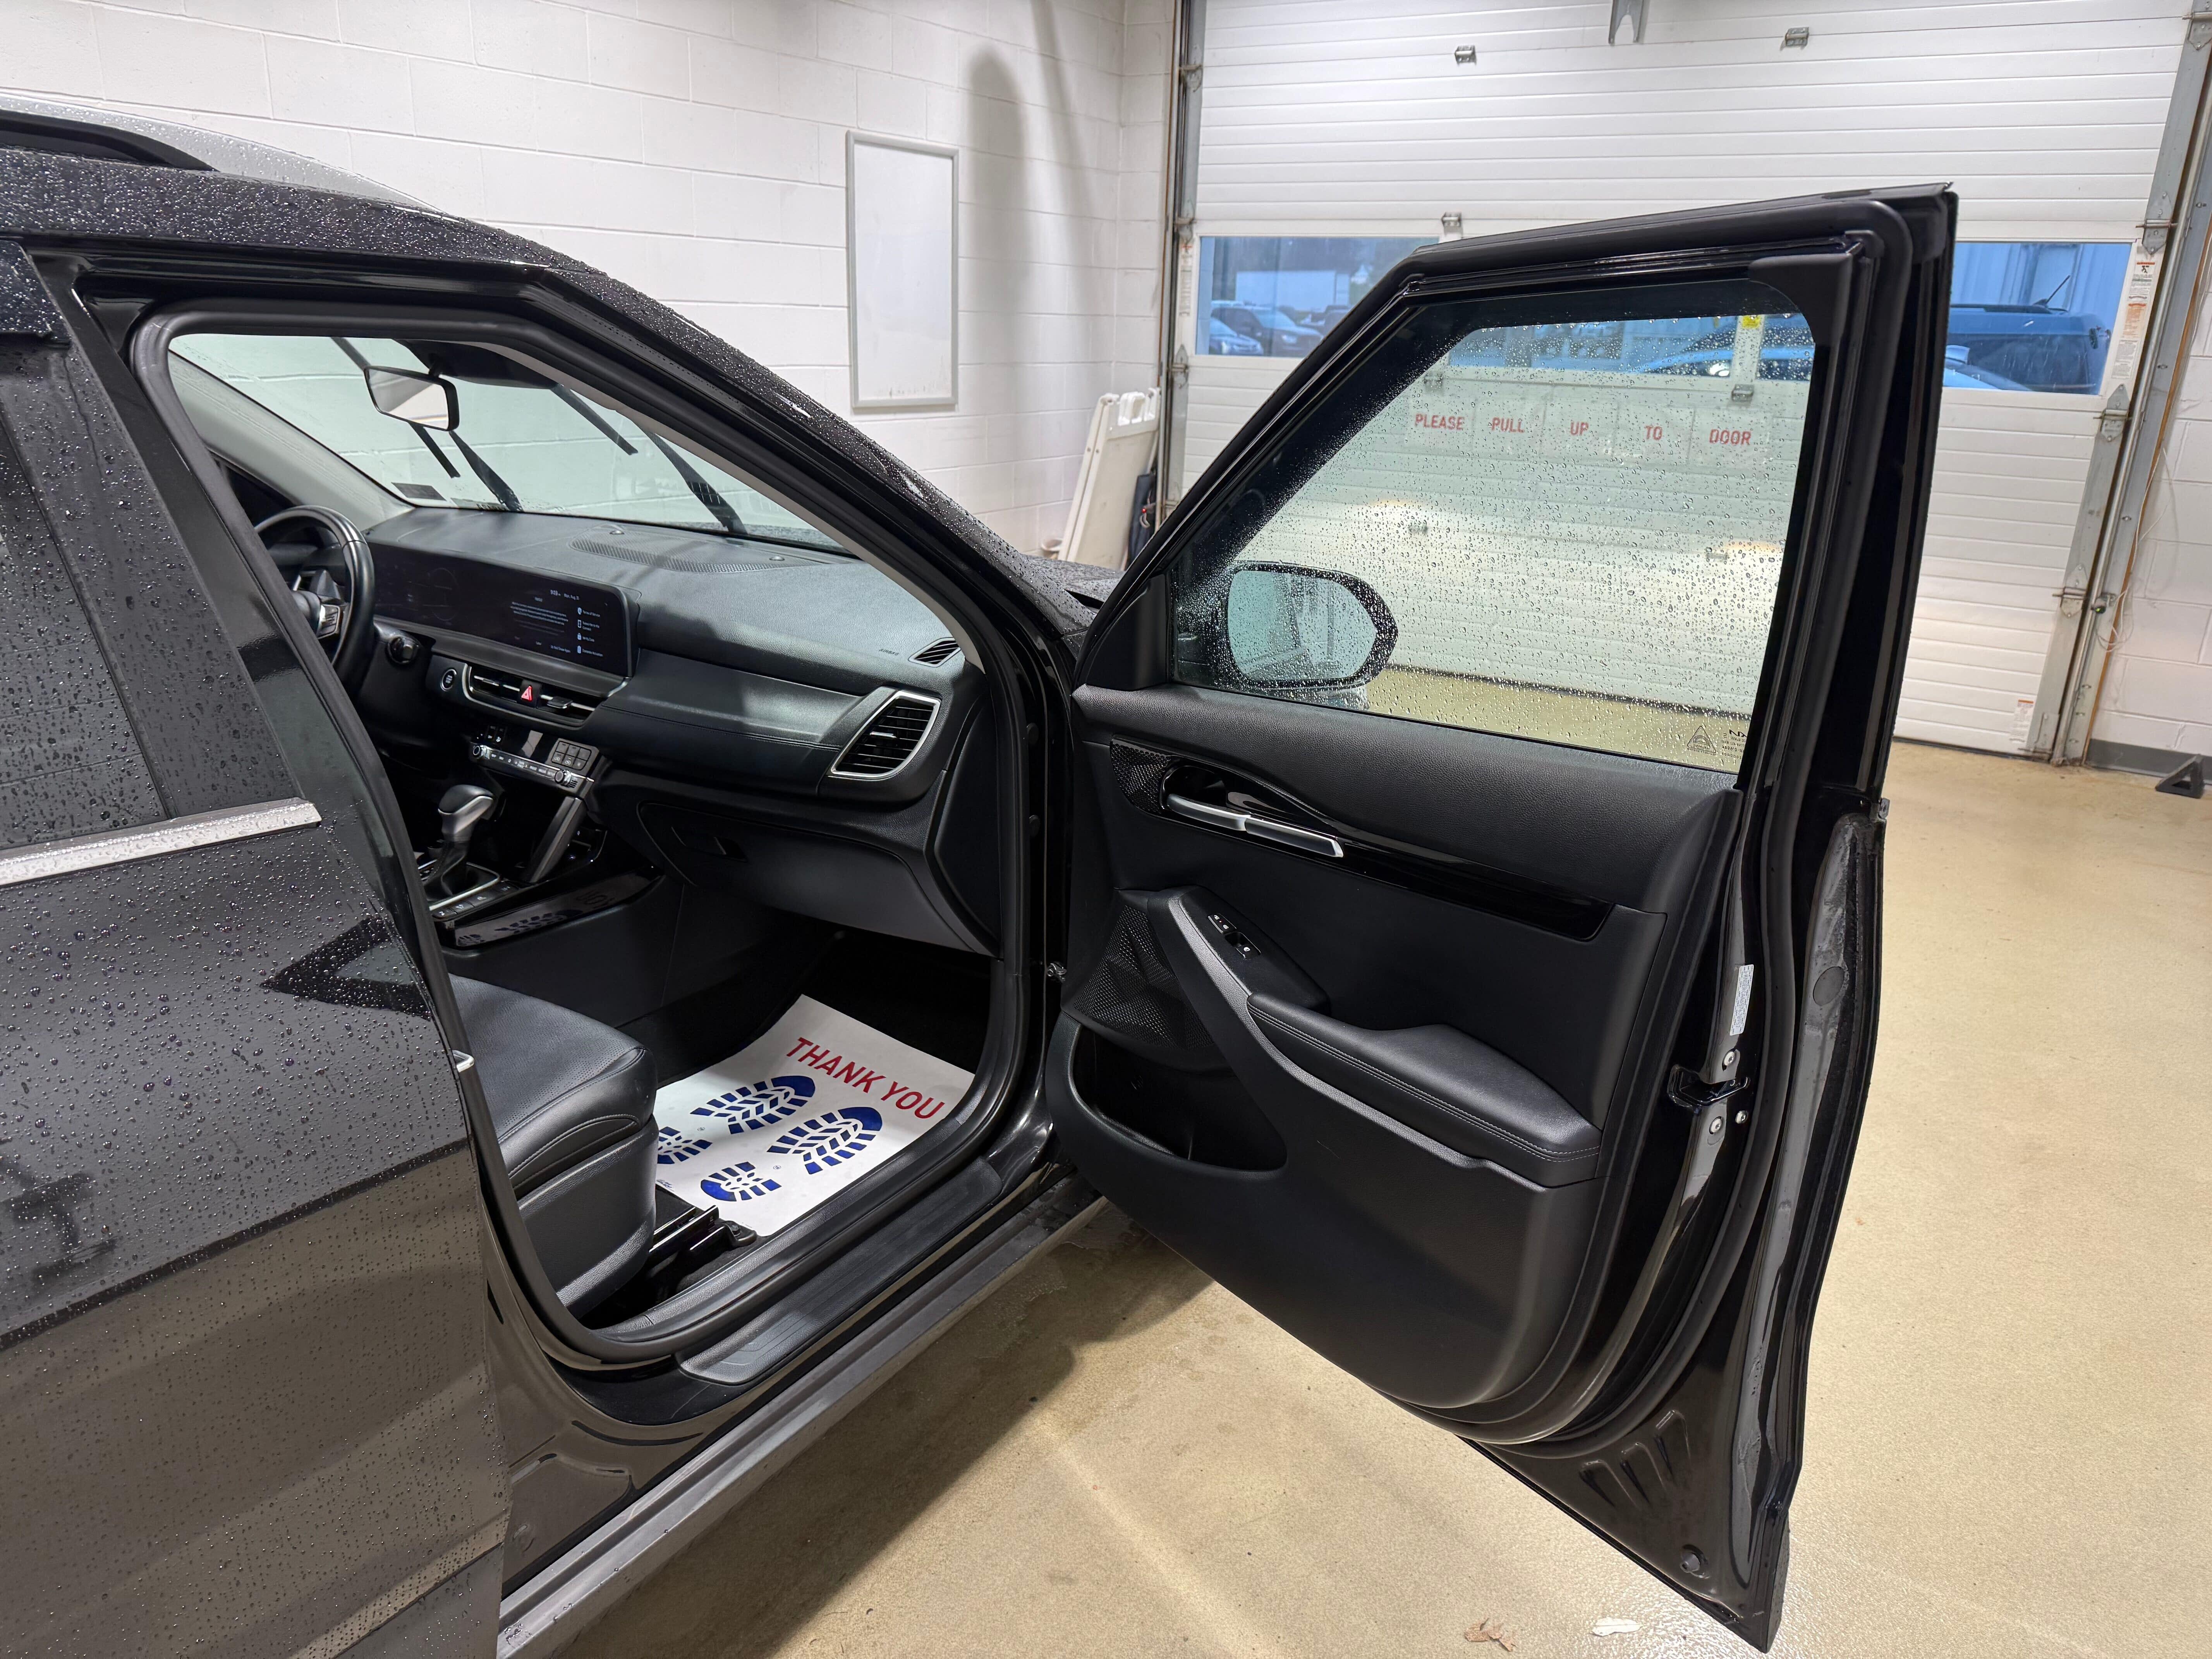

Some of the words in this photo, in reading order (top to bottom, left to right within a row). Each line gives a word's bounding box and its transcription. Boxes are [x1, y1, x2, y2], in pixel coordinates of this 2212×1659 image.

[1415, 414, 1465, 431] PLEASE
[1491, 417, 1525, 433] PULL
[1570, 421, 1589, 436] UP
[1644, 425, 1662, 440] TO
[1709, 429, 1751, 445] DOOR
[786, 1037, 886, 1093] THANK
[880, 1081, 945, 1119] YOU
